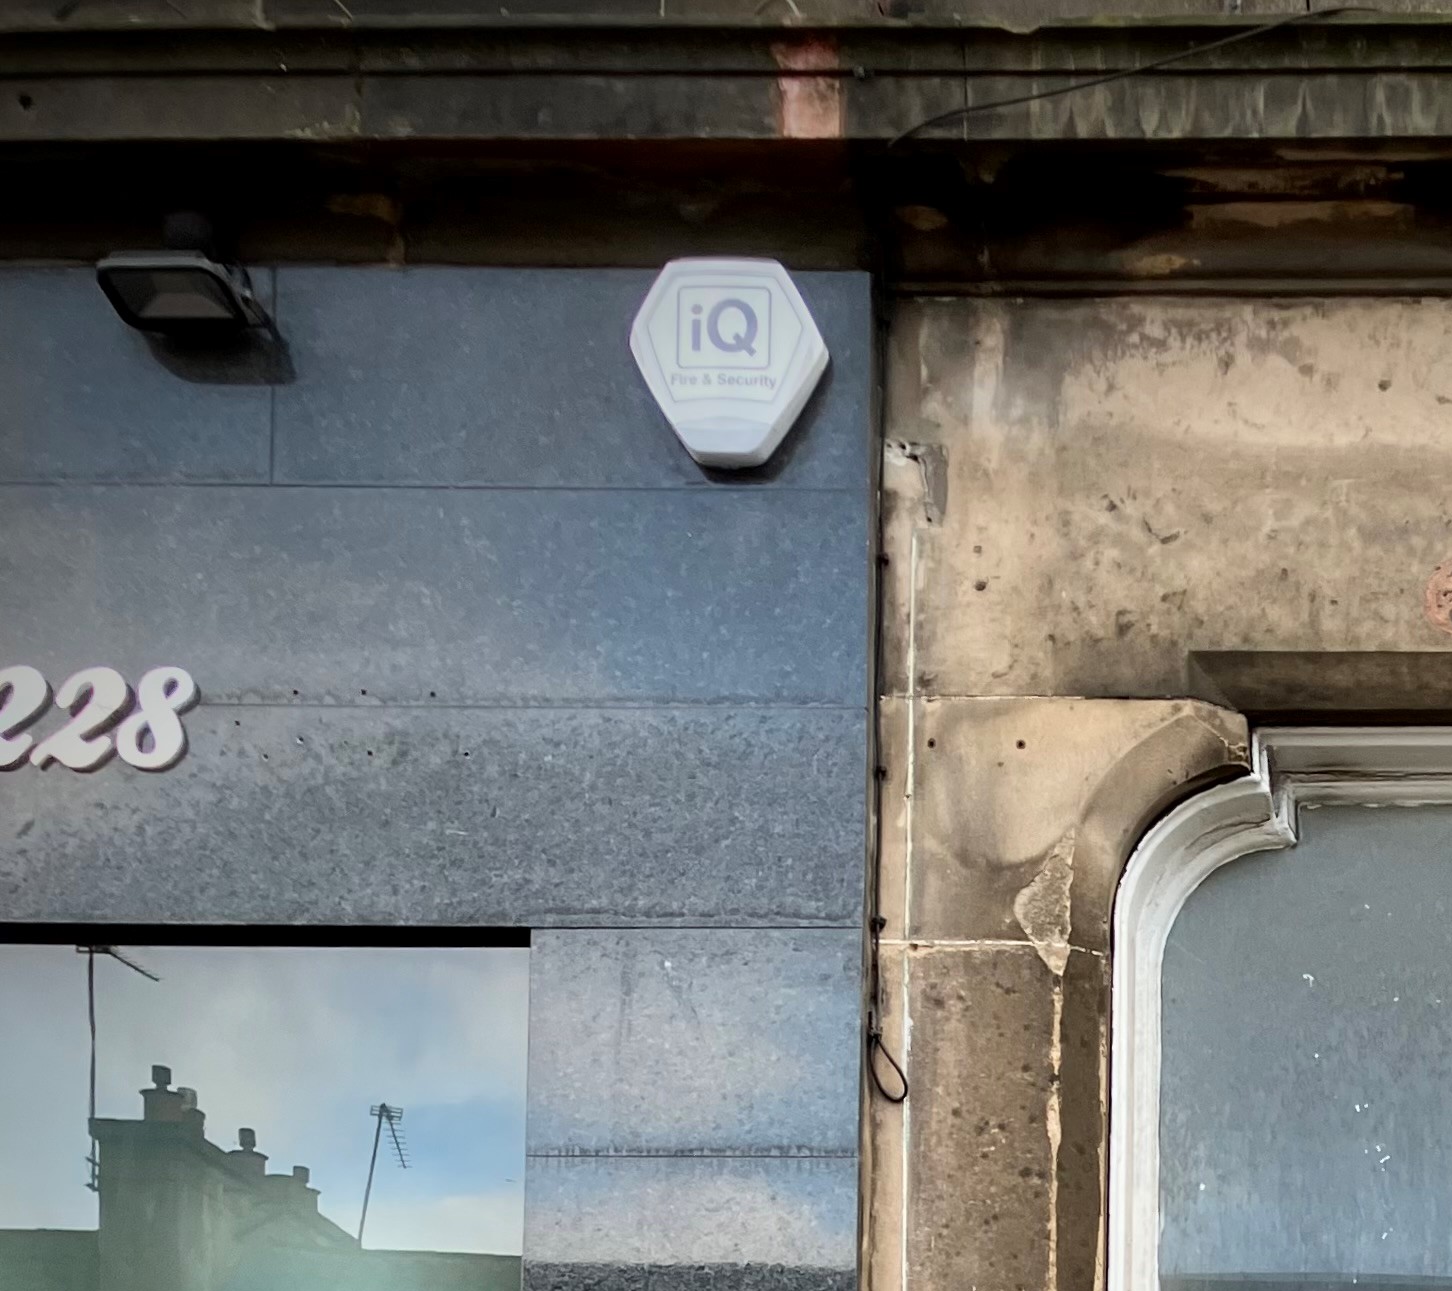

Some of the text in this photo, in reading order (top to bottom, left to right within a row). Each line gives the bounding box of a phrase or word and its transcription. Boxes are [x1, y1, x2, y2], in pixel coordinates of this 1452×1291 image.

[690, 299, 758, 357] iQ
[670, 374, 777, 390] Fire & Security
